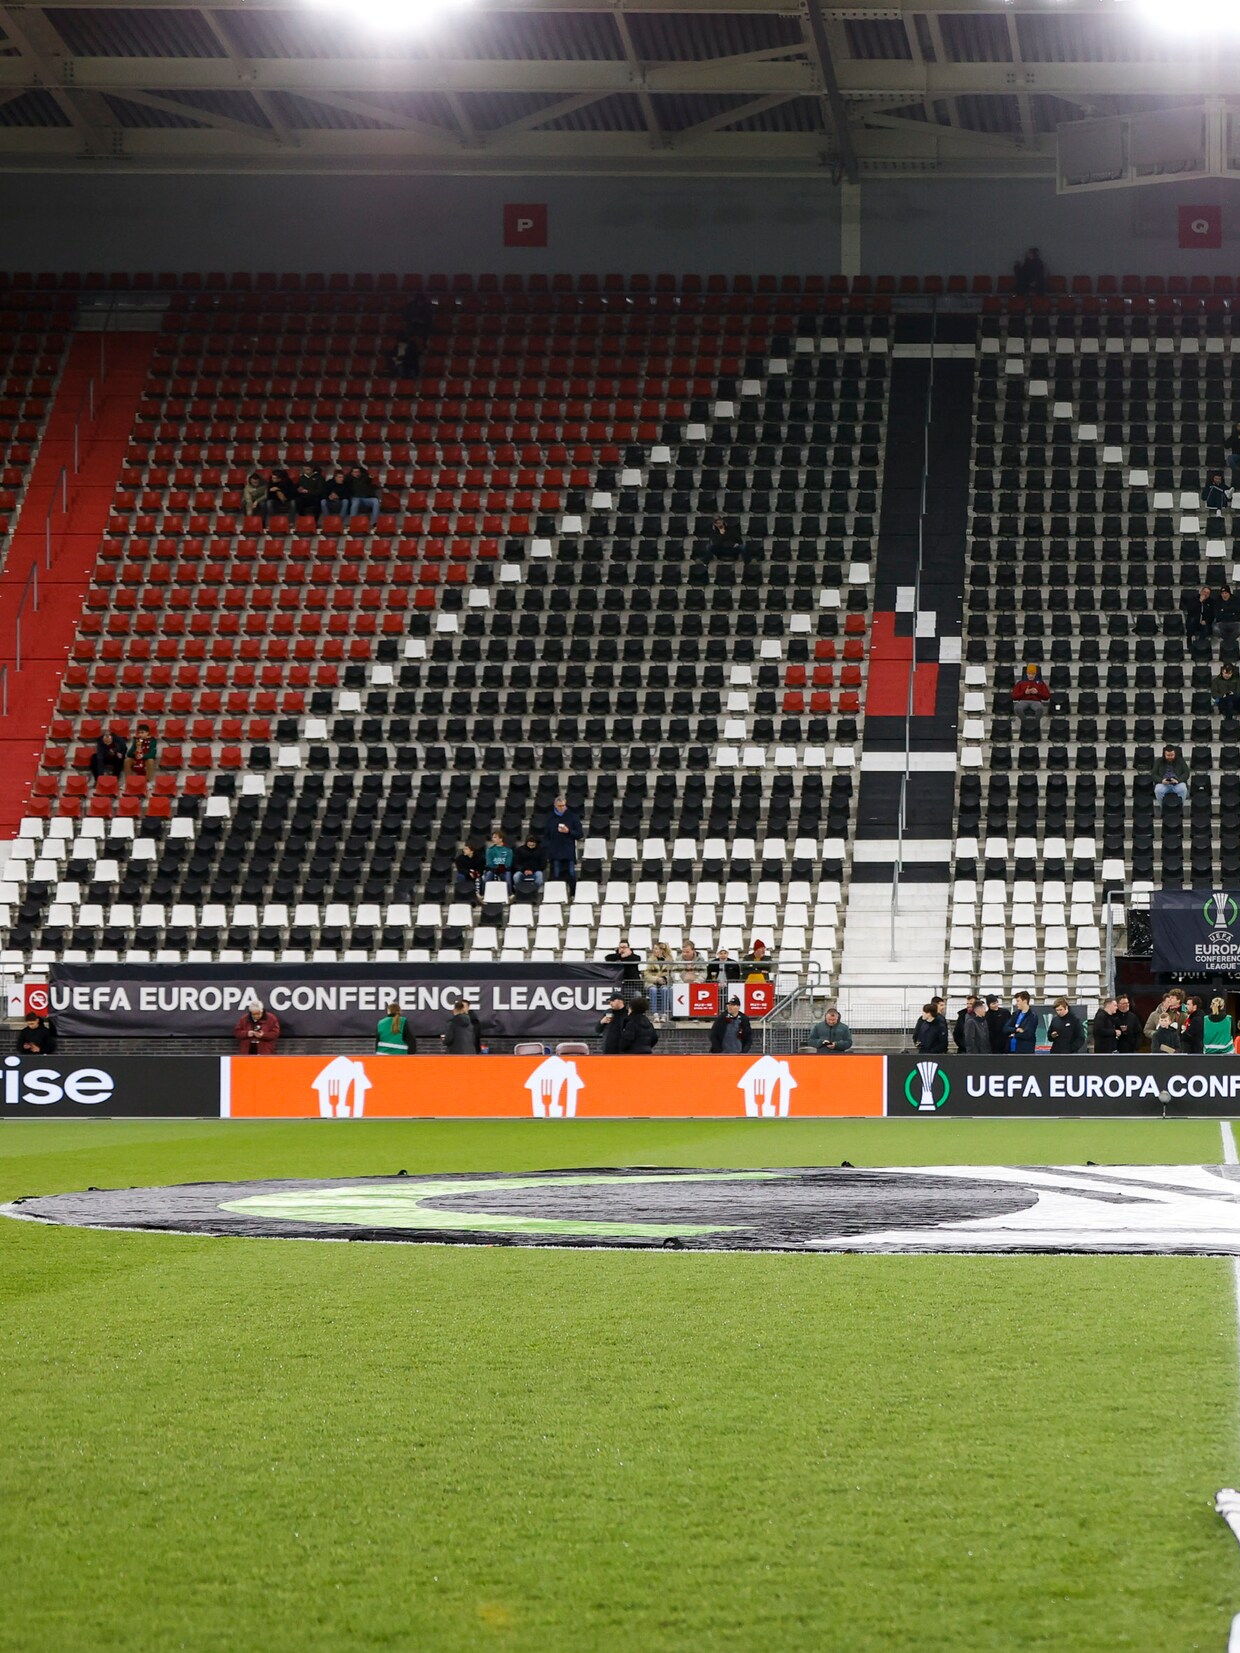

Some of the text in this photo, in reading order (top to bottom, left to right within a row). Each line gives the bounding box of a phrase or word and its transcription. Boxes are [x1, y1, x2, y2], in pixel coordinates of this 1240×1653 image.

[517, 219, 533, 233] P
[1191, 219, 1209, 235] Q
[1209, 932, 1232, 942] UEFA
[50, 986, 132, 1011] UEFA
[139, 986, 258, 1011] EUROPA
[269, 986, 481, 1011] CONFERENCE
[697, 990, 710, 1001] P
[752, 990, 765, 1002] Q
[0, 1056, 115, 1105] ise
[966, 1075, 1042, 1098] UEFA
[1049, 1075, 1160, 1098] EUROPA
